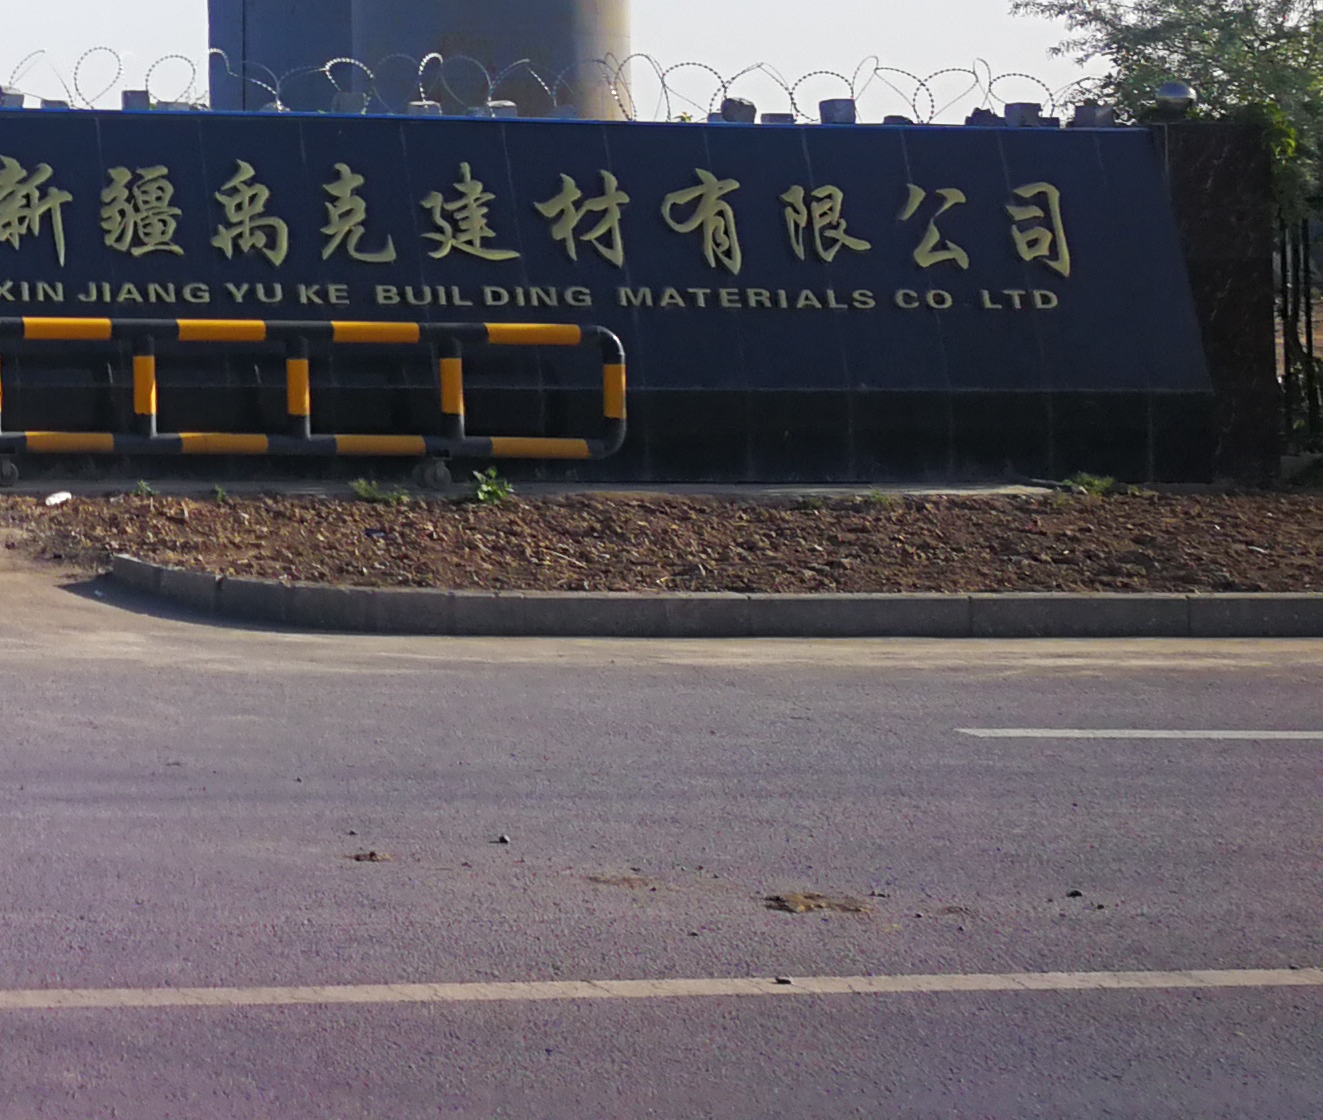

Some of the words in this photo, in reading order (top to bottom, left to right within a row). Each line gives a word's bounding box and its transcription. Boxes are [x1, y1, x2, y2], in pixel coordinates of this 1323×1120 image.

[77, 281, 211, 304] JIANG
[223, 282, 284, 304] YU
[299, 283, 351, 305] KE
[619, 287, 877, 310] MATERIALS
[980, 289, 1059, 310] LTD
